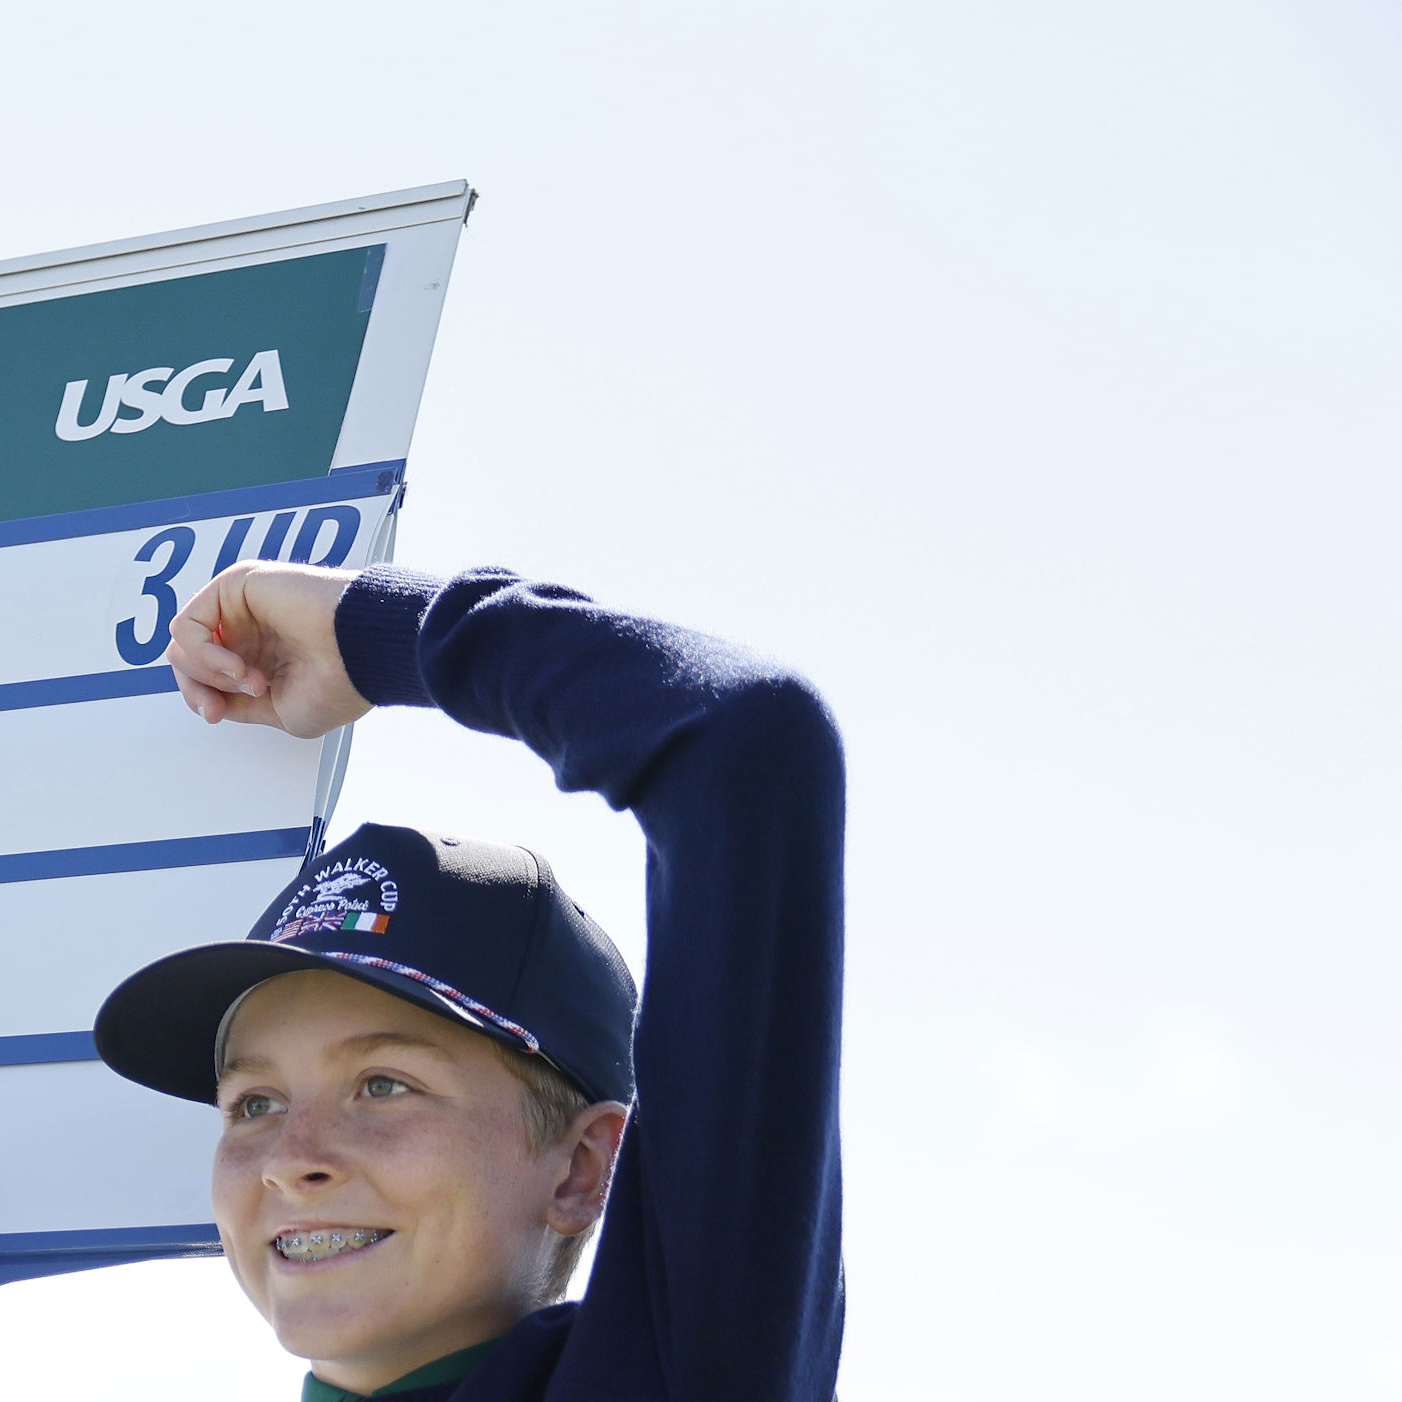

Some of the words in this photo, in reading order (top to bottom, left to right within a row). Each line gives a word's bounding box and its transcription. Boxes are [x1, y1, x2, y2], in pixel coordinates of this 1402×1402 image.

[55, 349, 289, 442] USGA
[115, 526, 196, 666] 3
[314, 858, 389, 881] WALKER
[379, 881, 399, 912] CUP
